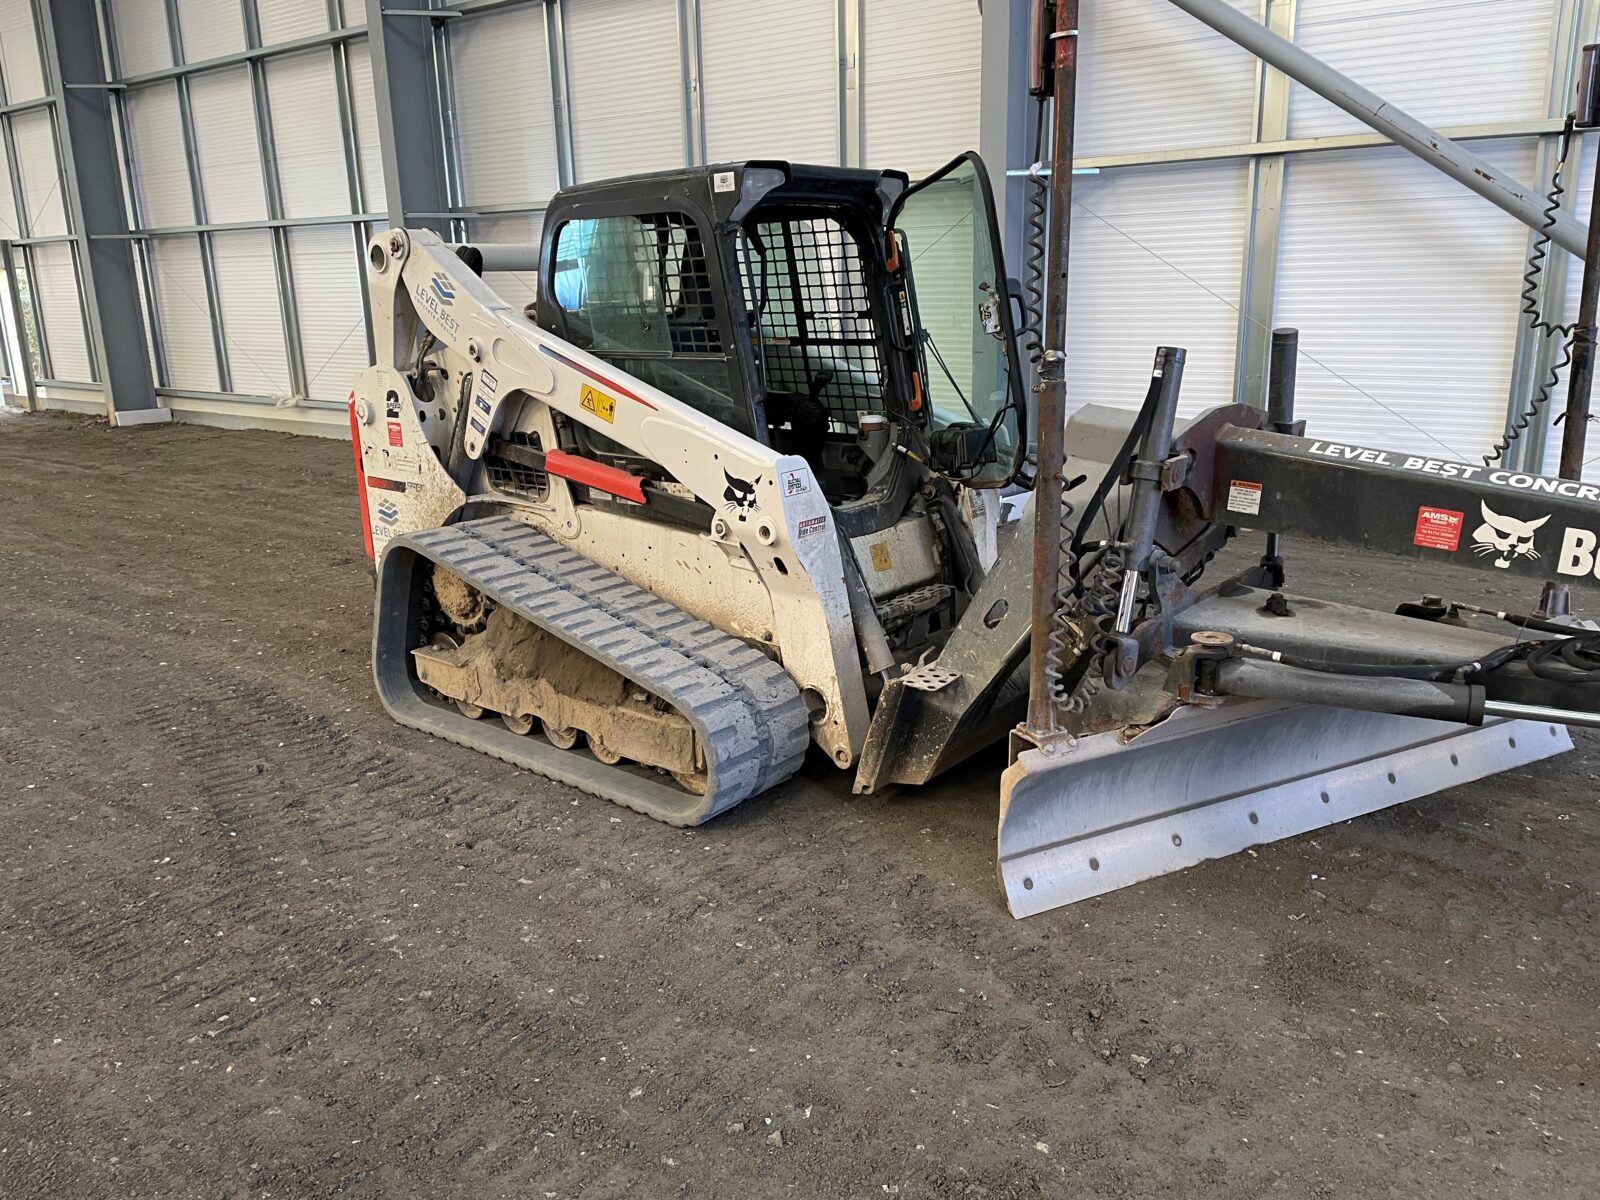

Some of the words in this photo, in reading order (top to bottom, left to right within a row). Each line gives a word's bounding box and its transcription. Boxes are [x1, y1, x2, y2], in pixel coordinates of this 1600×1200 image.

[416, 283, 438, 315] LEVEL
[440, 308, 460, 334] BEST
[386, 402, 402, 410] SPEED
[1308, 442, 1391, 466] LEVEL
[1403, 456, 1481, 478] BEST
[1489, 472, 1600, 501] CONCR
[1422, 511, 1449, 521] AMS
[372, 525, 392, 537] LEVEL
